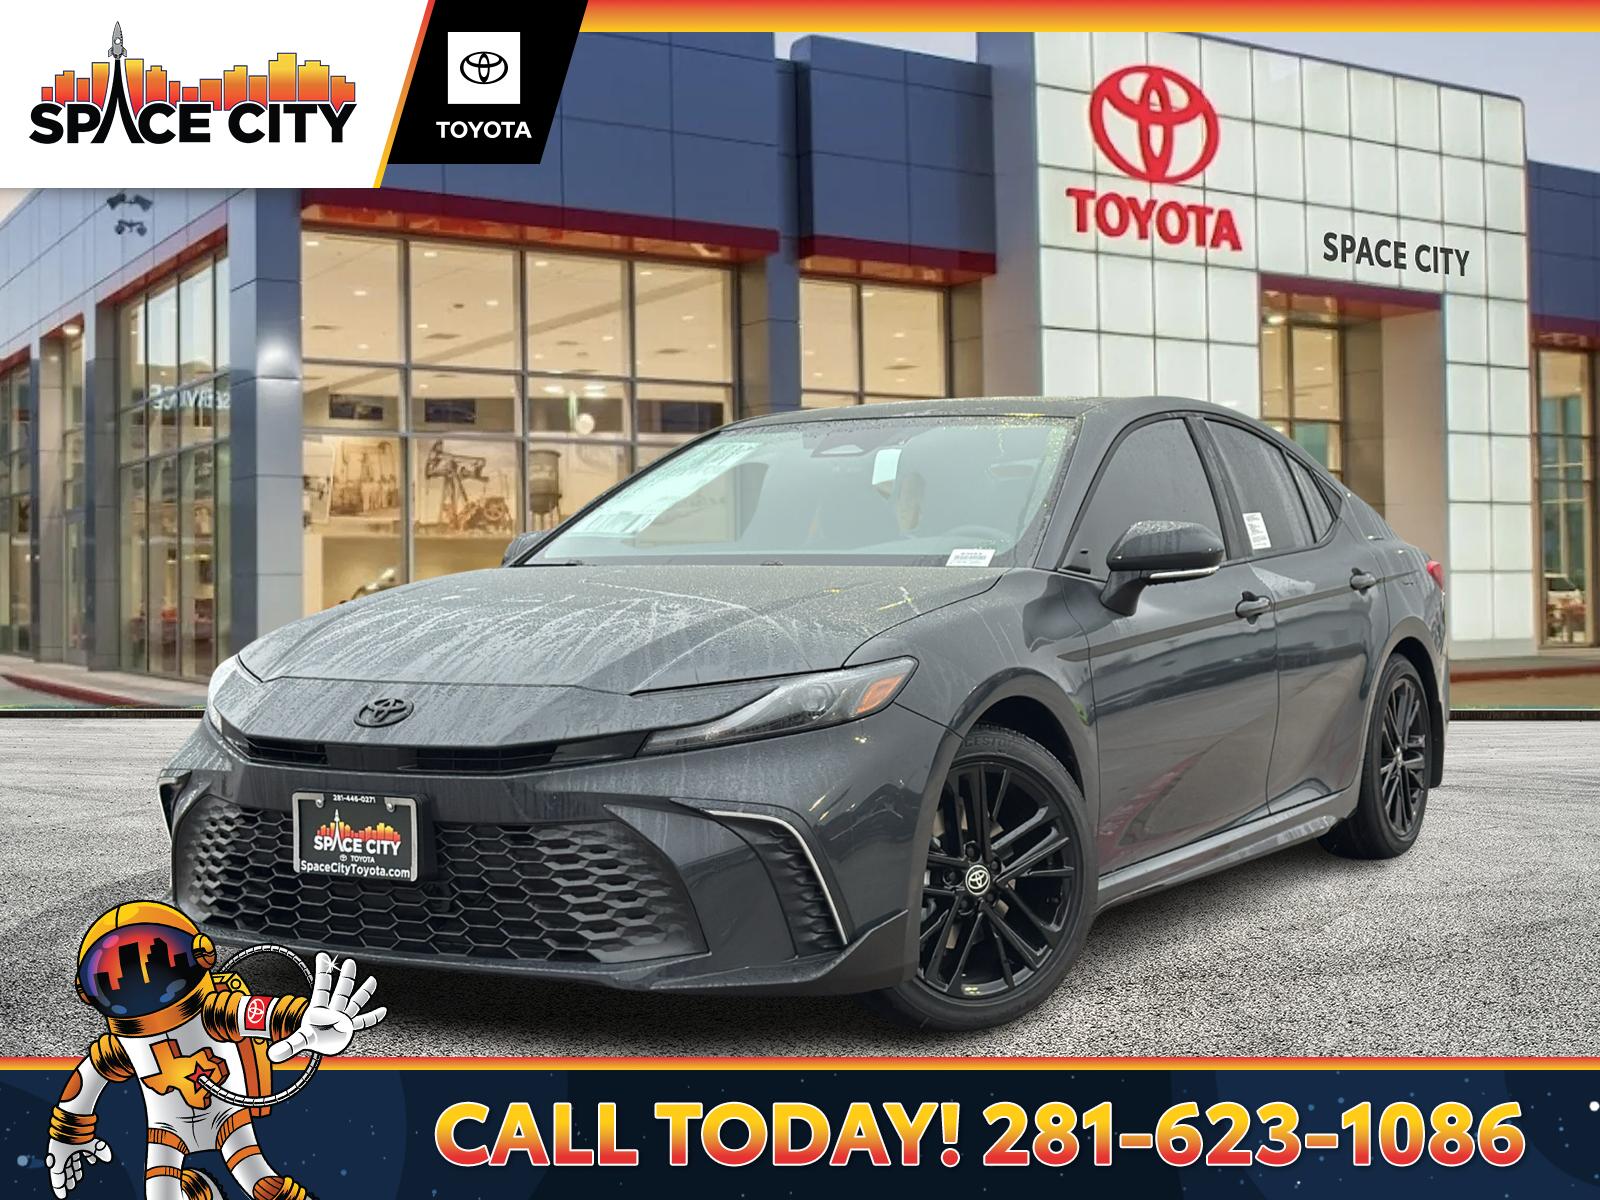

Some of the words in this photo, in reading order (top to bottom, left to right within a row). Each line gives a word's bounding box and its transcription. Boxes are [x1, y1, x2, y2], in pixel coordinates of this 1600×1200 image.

[1066, 187, 1243, 252] TOYOTA
[1322, 232, 1407, 270] SPACE
[1414, 244, 1470, 277] CITY
[313, 829, 363, 853] SPACE
[365, 838, 401, 856] CITY
[300, 860, 410, 878] SpaceCityToyota.com
[351, 856, 375, 864] TOYOTA
